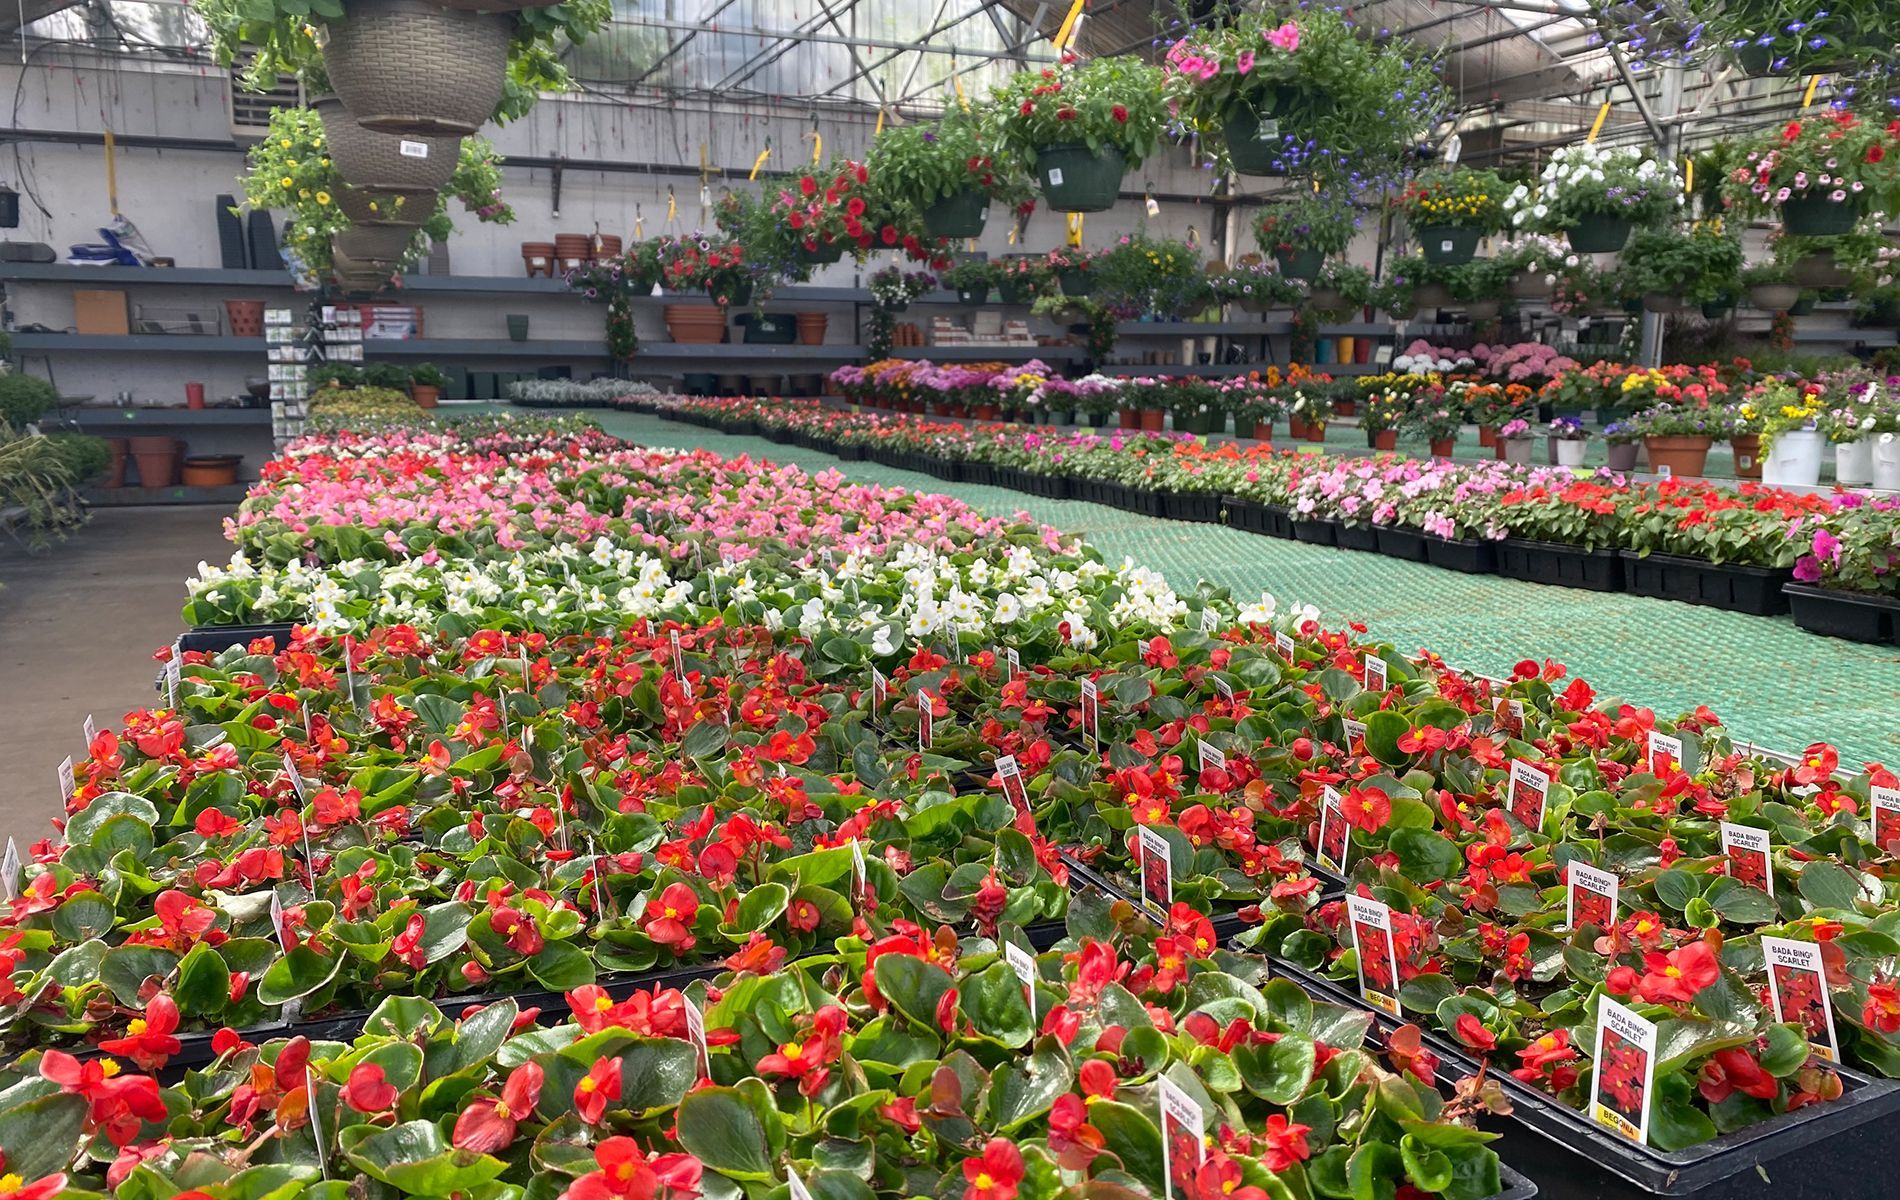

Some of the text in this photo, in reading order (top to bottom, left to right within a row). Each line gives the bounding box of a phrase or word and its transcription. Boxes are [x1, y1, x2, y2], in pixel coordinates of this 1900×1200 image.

[1518, 768, 1530, 777] BADA
[1520, 775, 1540, 787] SCARLET
[1878, 794, 1894, 802] BADA
[1143, 832, 1154, 844] BADA
[1728, 831, 1745, 840] BADA
[1146, 841, 1163, 854] SCARLET
[1733, 839, 1758, 848] SCARLET
[1576, 870, 1592, 880] BADA
[1579, 878, 1606, 892] SCARLET
[1354, 905, 1368, 914] BADA
[1358, 913, 1380, 925] SCARLET
[1772, 946, 1792, 956] BADA
[1778, 955, 1810, 967] SCARLET
[1608, 1008, 1627, 1025] BADA
[1611, 1020, 1641, 1043] SCARLET
[1811, 1047, 1826, 1056] ONIA
[1604, 1110, 1634, 1135] BEGONIA
